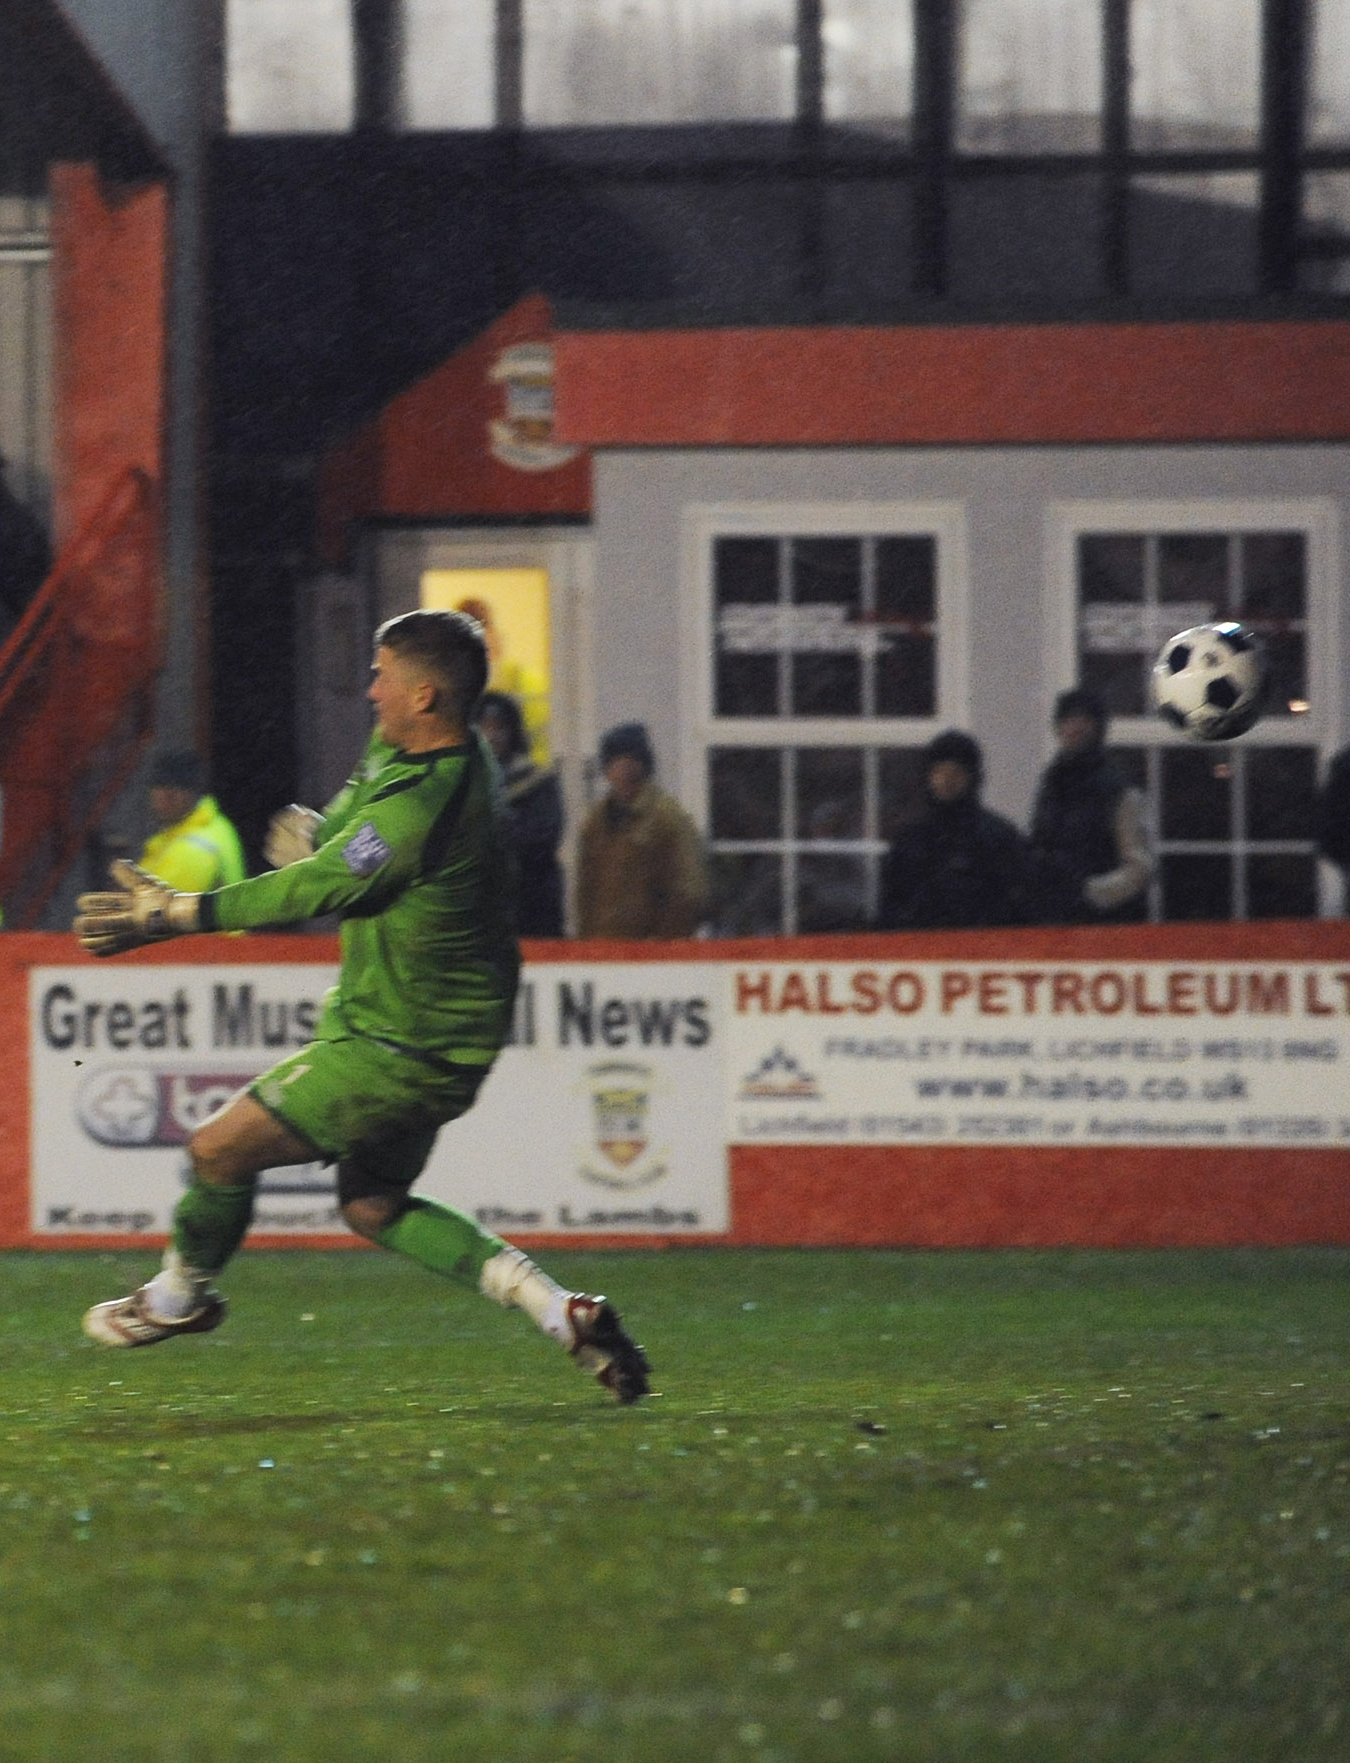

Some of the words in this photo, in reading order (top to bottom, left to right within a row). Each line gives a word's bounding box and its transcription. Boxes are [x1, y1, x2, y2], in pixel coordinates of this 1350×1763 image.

[735, 969, 927, 1017] HALSO
[940, 969, 1292, 1018] PETROLEUM
[41, 984, 192, 1049] Great
[211, 982, 318, 1048] Mus
[558, 981, 711, 1047] News
[916, 1072, 1249, 1102] www.halso.co.uk
[48, 1207, 155, 1232] Keep
[475, 1206, 541, 1225] the
[558, 1205, 700, 1226] Lambs
